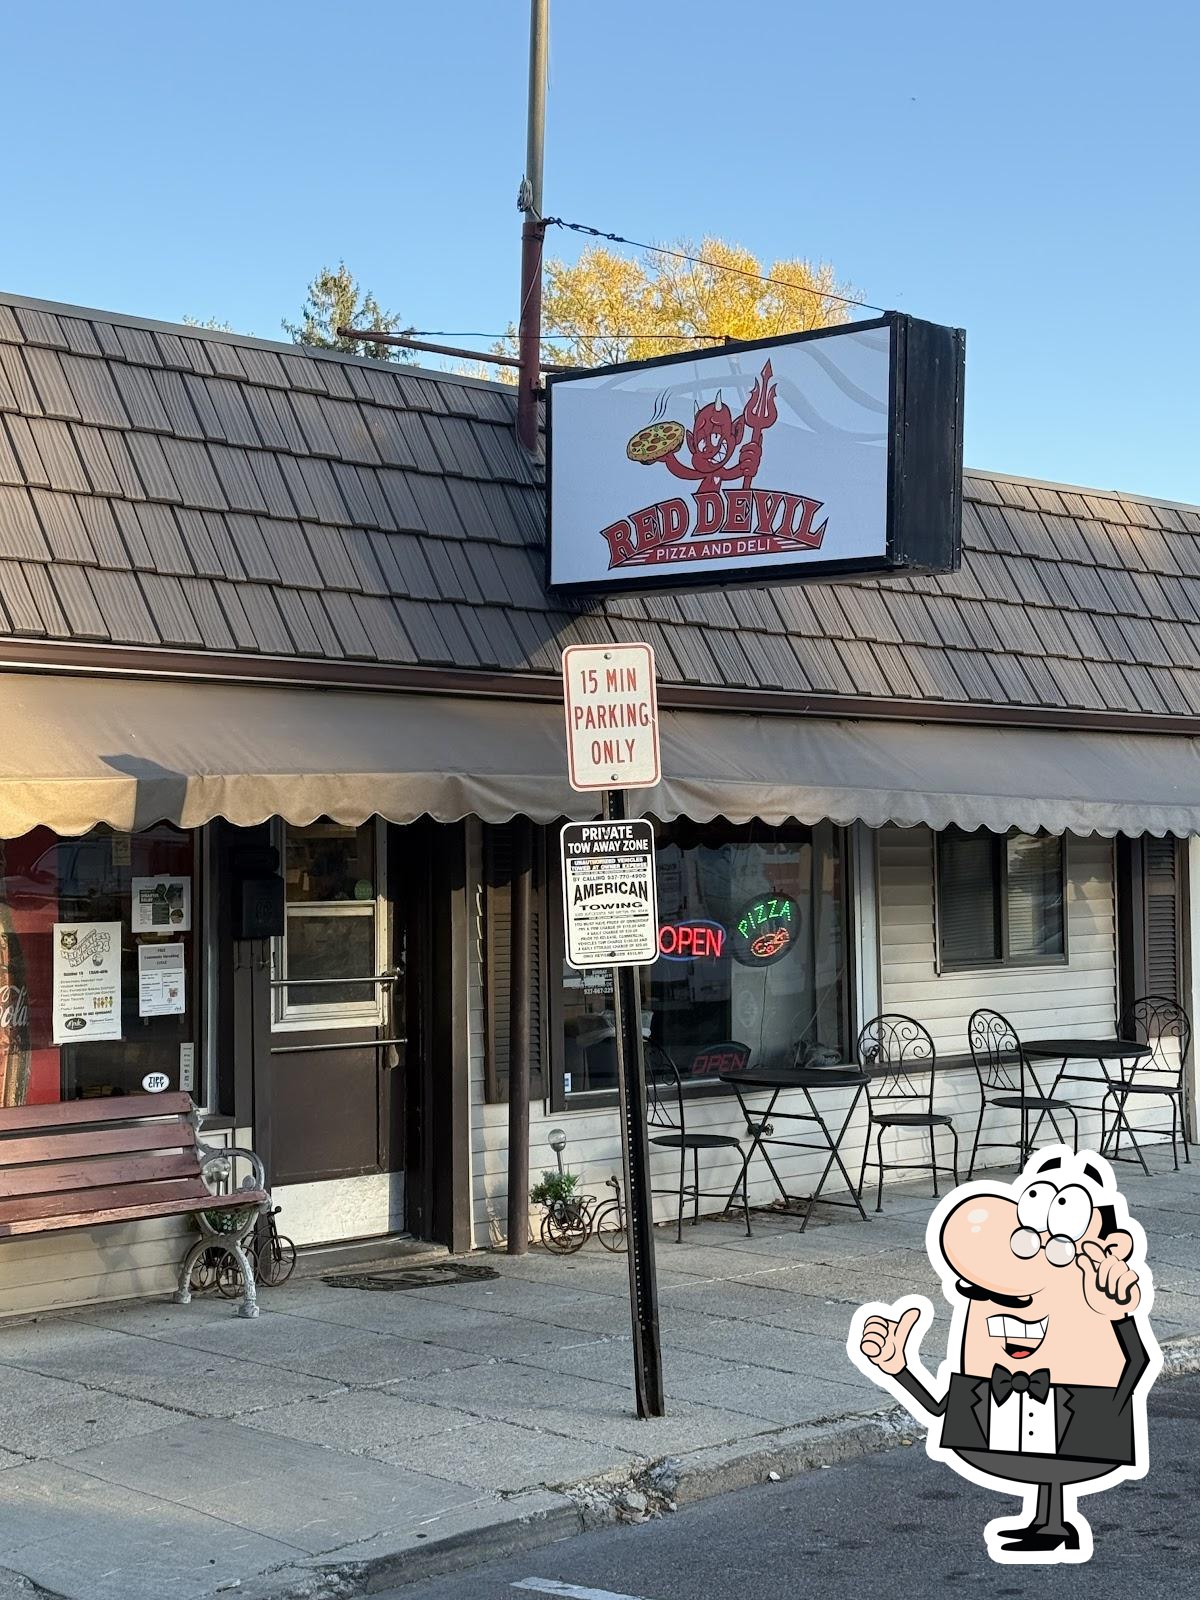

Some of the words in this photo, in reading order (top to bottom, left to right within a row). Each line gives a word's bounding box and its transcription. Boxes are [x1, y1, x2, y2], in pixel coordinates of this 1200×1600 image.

[600, 497, 690, 570] RED
[690, 488, 830, 550] DEVIL
[656, 546, 697, 561] PIZZA
[701, 542, 732, 557] AND
[737, 539, 770, 553] DELI
[580, 669, 598, 694] 15
[606, 667, 637, 693] MIN
[574, 702, 649, 730] PARKING
[591, 738, 635, 765] ONLY
[568, 842, 591, 854] TOW
[593, 840, 621, 853] AWAY
[622, 838, 649, 852] ZONE
[582, 825, 634, 842] PRIVATE
[573, 880, 649, 906] AMERICAN
[579, 901, 643, 911] TOWING
[737, 899, 791, 939] PIZZA
[658, 925, 723, 957] OPEN
[691, 1053, 746, 1074] OPEN
